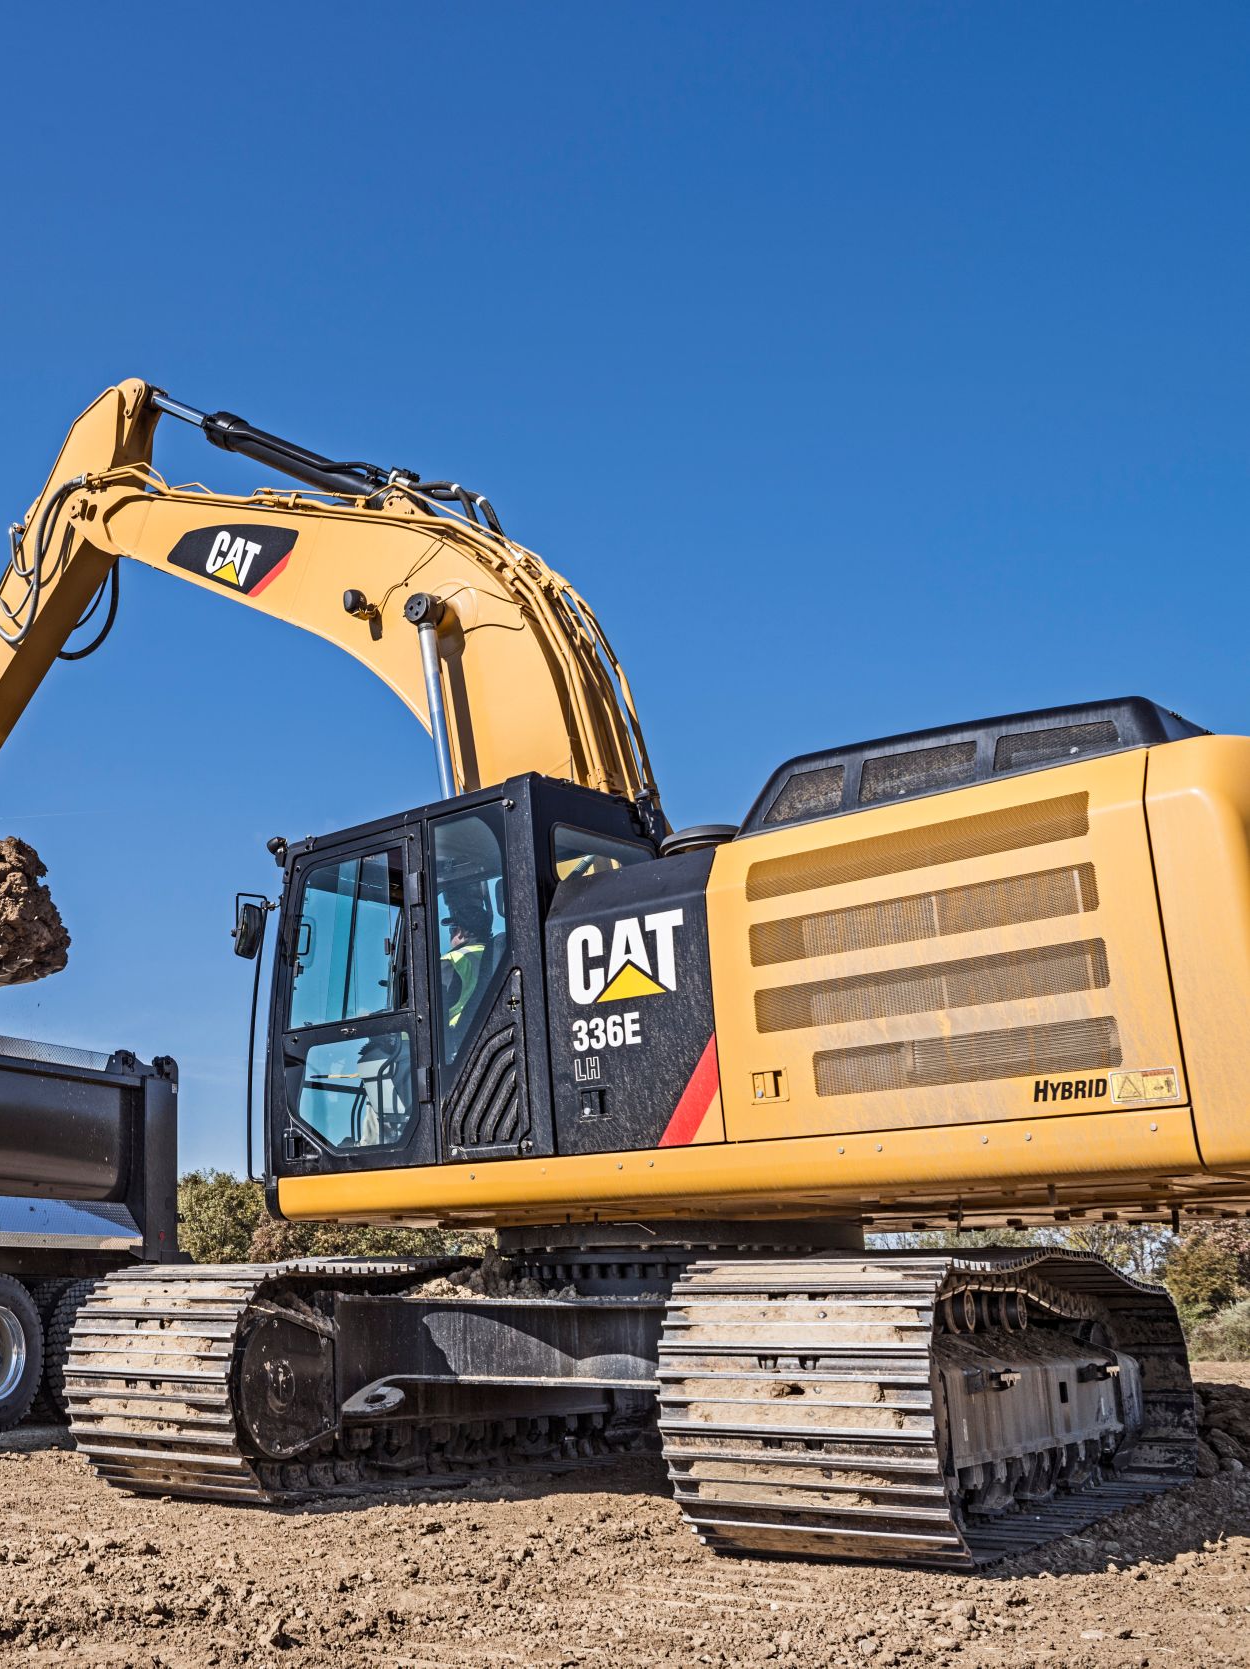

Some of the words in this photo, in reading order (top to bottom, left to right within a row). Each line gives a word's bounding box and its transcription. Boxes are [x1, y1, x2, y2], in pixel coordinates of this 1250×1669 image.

[205, 530, 262, 587] CAT
[566, 908, 684, 1005] CAT
[572, 1011, 642, 1052] 336E
[574, 1056, 601, 1082] LH
[1033, 1078, 1108, 1103] HYBRID
